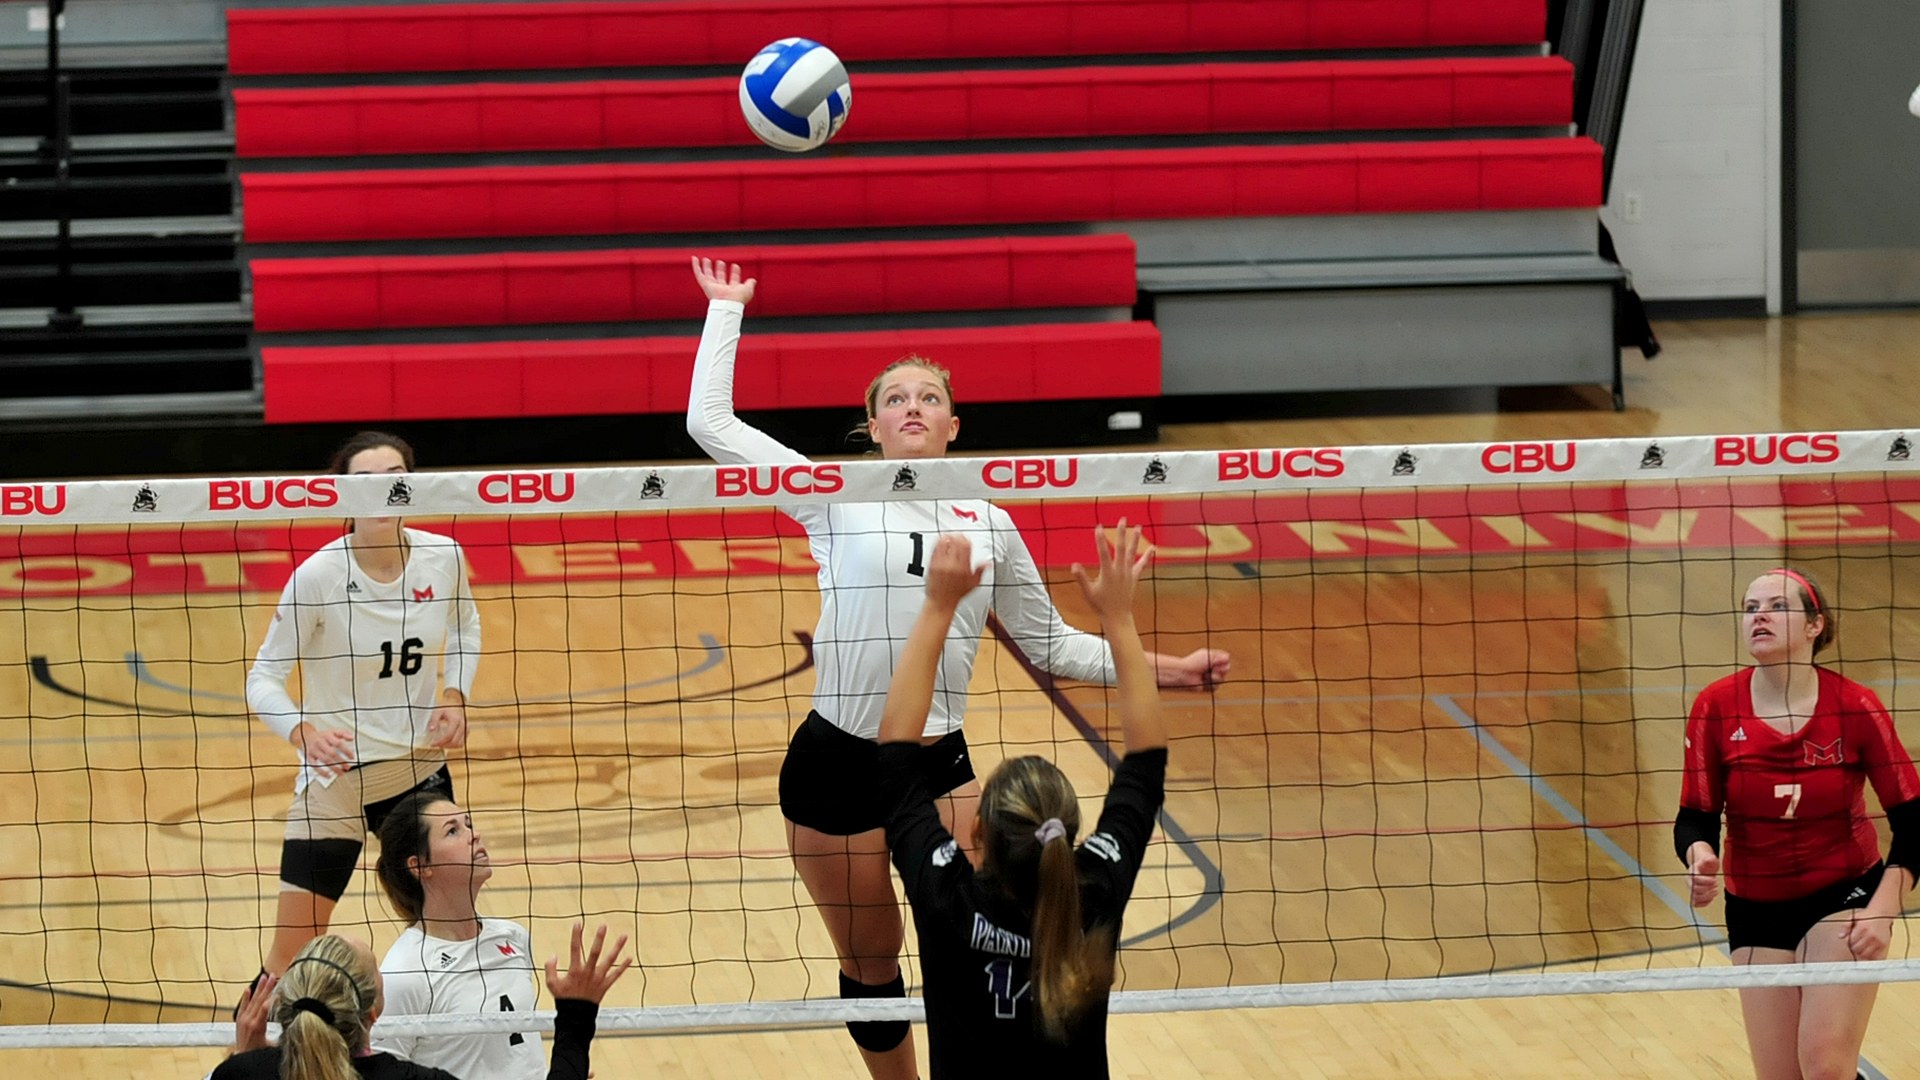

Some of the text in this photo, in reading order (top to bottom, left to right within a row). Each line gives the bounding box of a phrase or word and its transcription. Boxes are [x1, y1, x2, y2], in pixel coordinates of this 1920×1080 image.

[209, 478, 339, 511] BUCS
[477, 472, 575, 504] CBU
[715, 464, 844, 497] BUCS
[981, 458, 1078, 489] CBU
[1218, 449, 1345, 482] BUCS
[1481, 442, 1577, 474] CBU
[1714, 434, 1840, 467] BUCS
[1103, 503, 1920, 557] UNIVE
[379, 637, 424, 679] 16
[1803, 737, 1844, 766] M
[1774, 784, 1801, 819] 7
